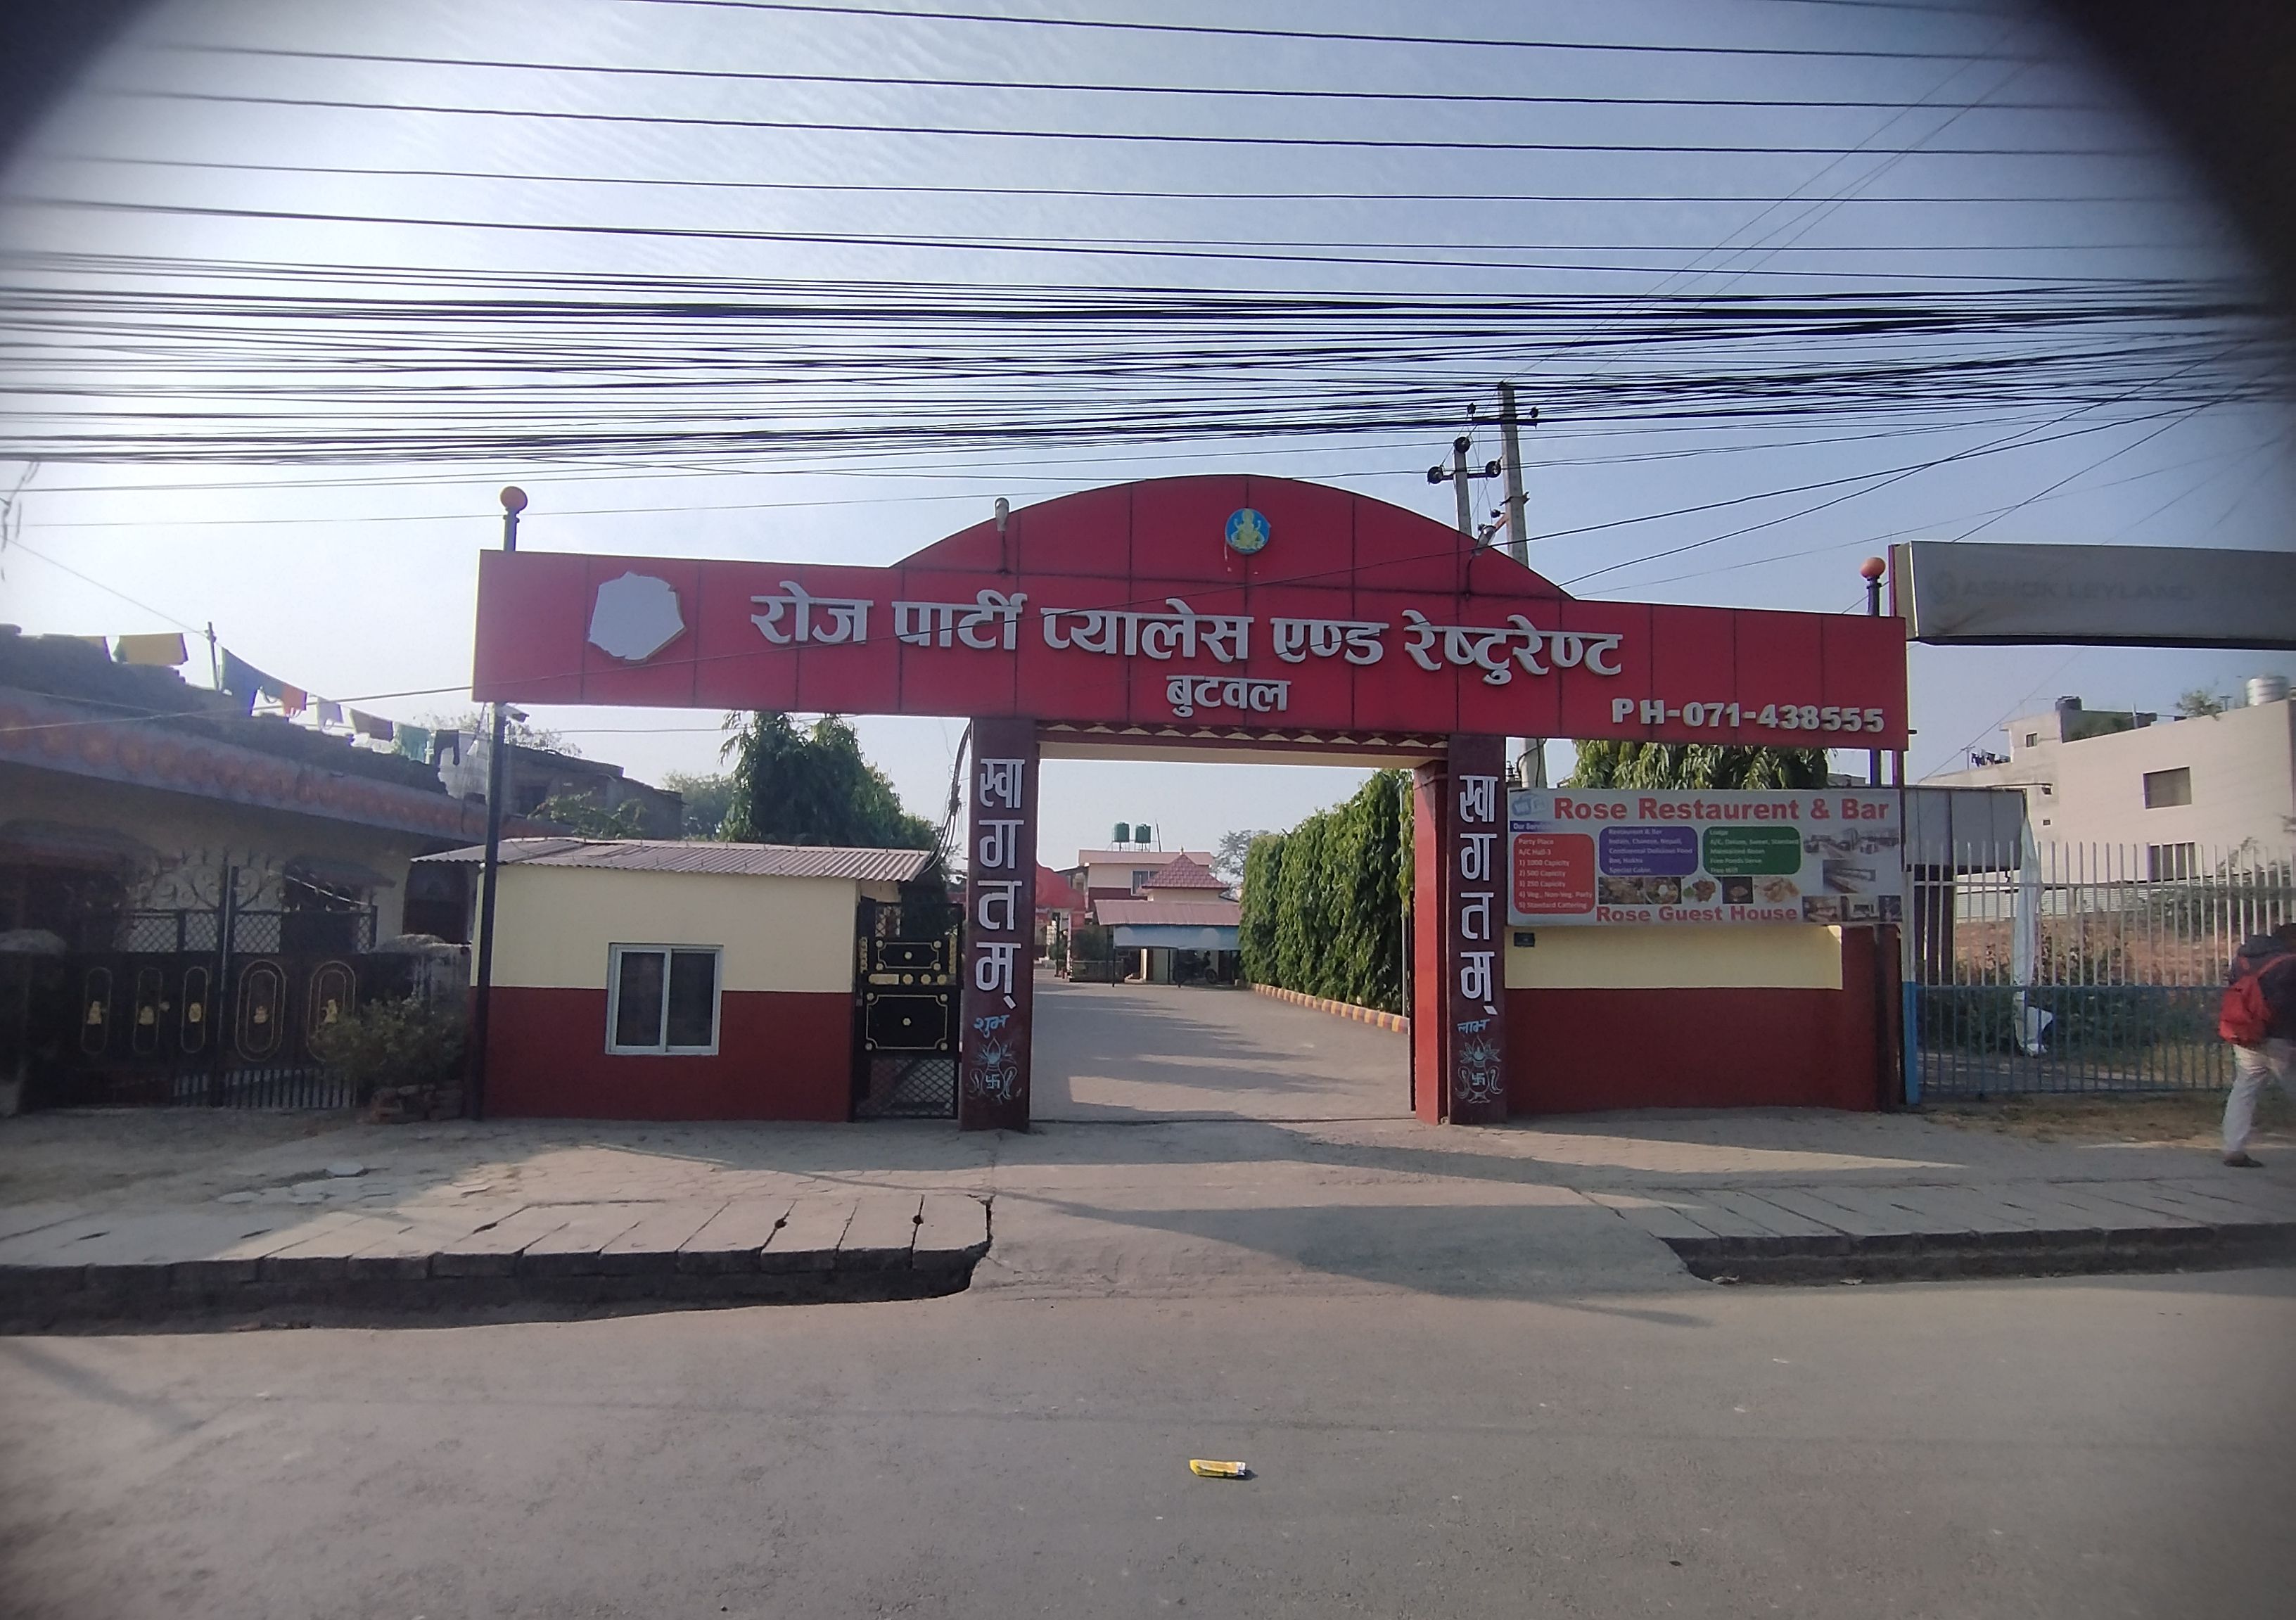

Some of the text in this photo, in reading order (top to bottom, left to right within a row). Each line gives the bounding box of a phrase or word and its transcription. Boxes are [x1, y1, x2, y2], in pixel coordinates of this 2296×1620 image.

[751, 580, 1624, 686] रोज पार्टी प्यालेस एण्ड रेष्टुरेण्ट
[1166, 675, 1292, 717] बुटवल
[1553, 797, 1889, 820] Rose Restaurent & Bar
[1595, 905, 1798, 923] Rose Guest House
[974, 1014, 1011, 1039] शुभ
[1457, 1018, 1491, 1034] लाभ
